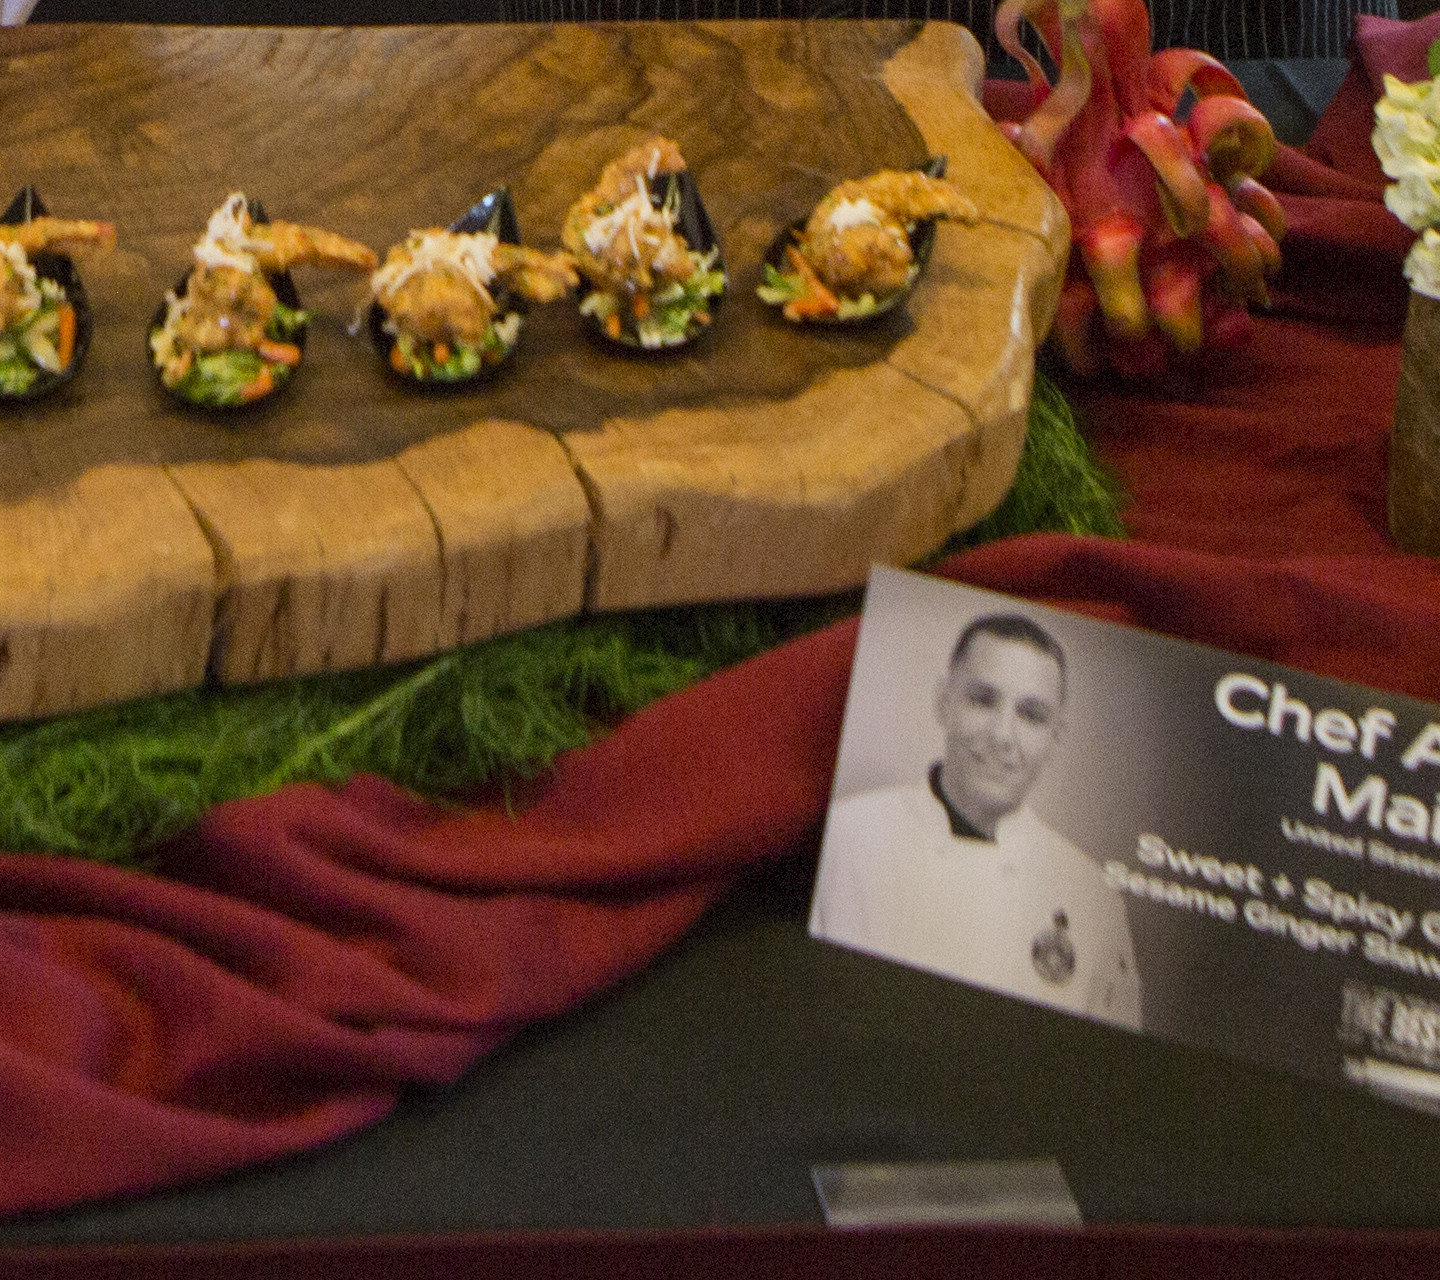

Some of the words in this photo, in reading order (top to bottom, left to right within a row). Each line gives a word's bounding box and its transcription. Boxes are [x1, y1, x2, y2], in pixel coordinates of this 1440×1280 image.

[1214, 673, 1398, 760] Chef
[1103, 859, 1236, 923] Sesame
[1242, 898, 1358, 954] Ginger
[1136, 832, 1264, 896] Sweet
[1302, 877, 1414, 940] Spicy
